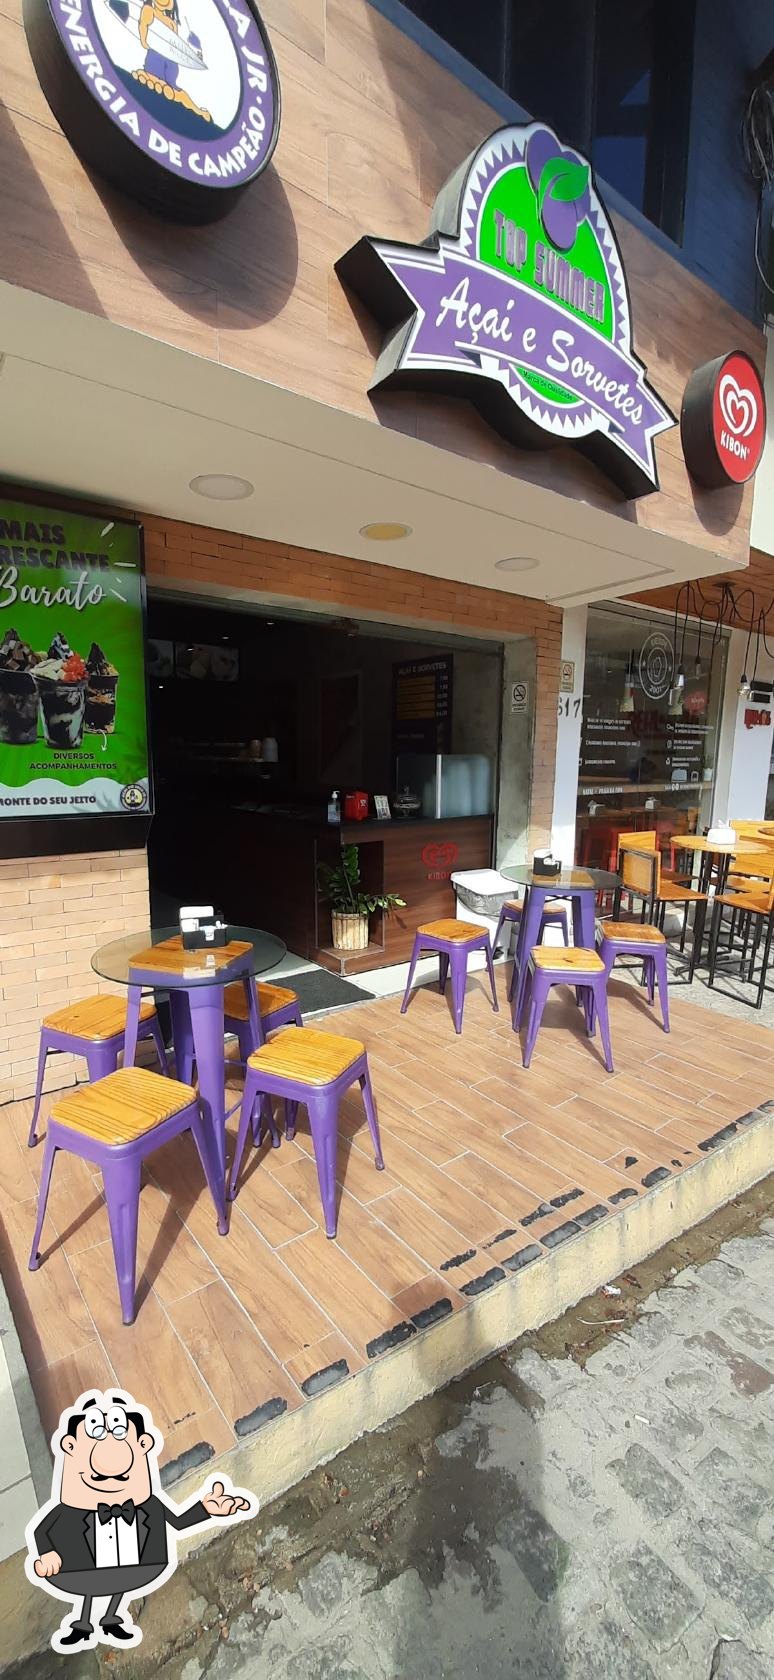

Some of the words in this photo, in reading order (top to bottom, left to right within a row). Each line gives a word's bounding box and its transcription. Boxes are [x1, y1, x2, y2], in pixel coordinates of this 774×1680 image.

[241, 45, 267, 92] JR
[148, 129, 182, 167] DE
[188, 106, 266, 178] CAMPEÃO
[494, 208, 528, 273] TOP
[534, 240, 605, 325] SUMMER
[522, 327, 537, 353] e
[546, 329, 644, 425] Sorvetes
[0, 518, 65, 546] MAIS
[0, 565, 106, 611] Barato
[29, 762, 117, 770] ACOMPANHAMENTOS
[53, 752, 95, 760] DIVERSOS
[33, 797, 48, 805] DO
[49, 796, 68, 805] SEU
[69, 795, 97, 804] JEITO
